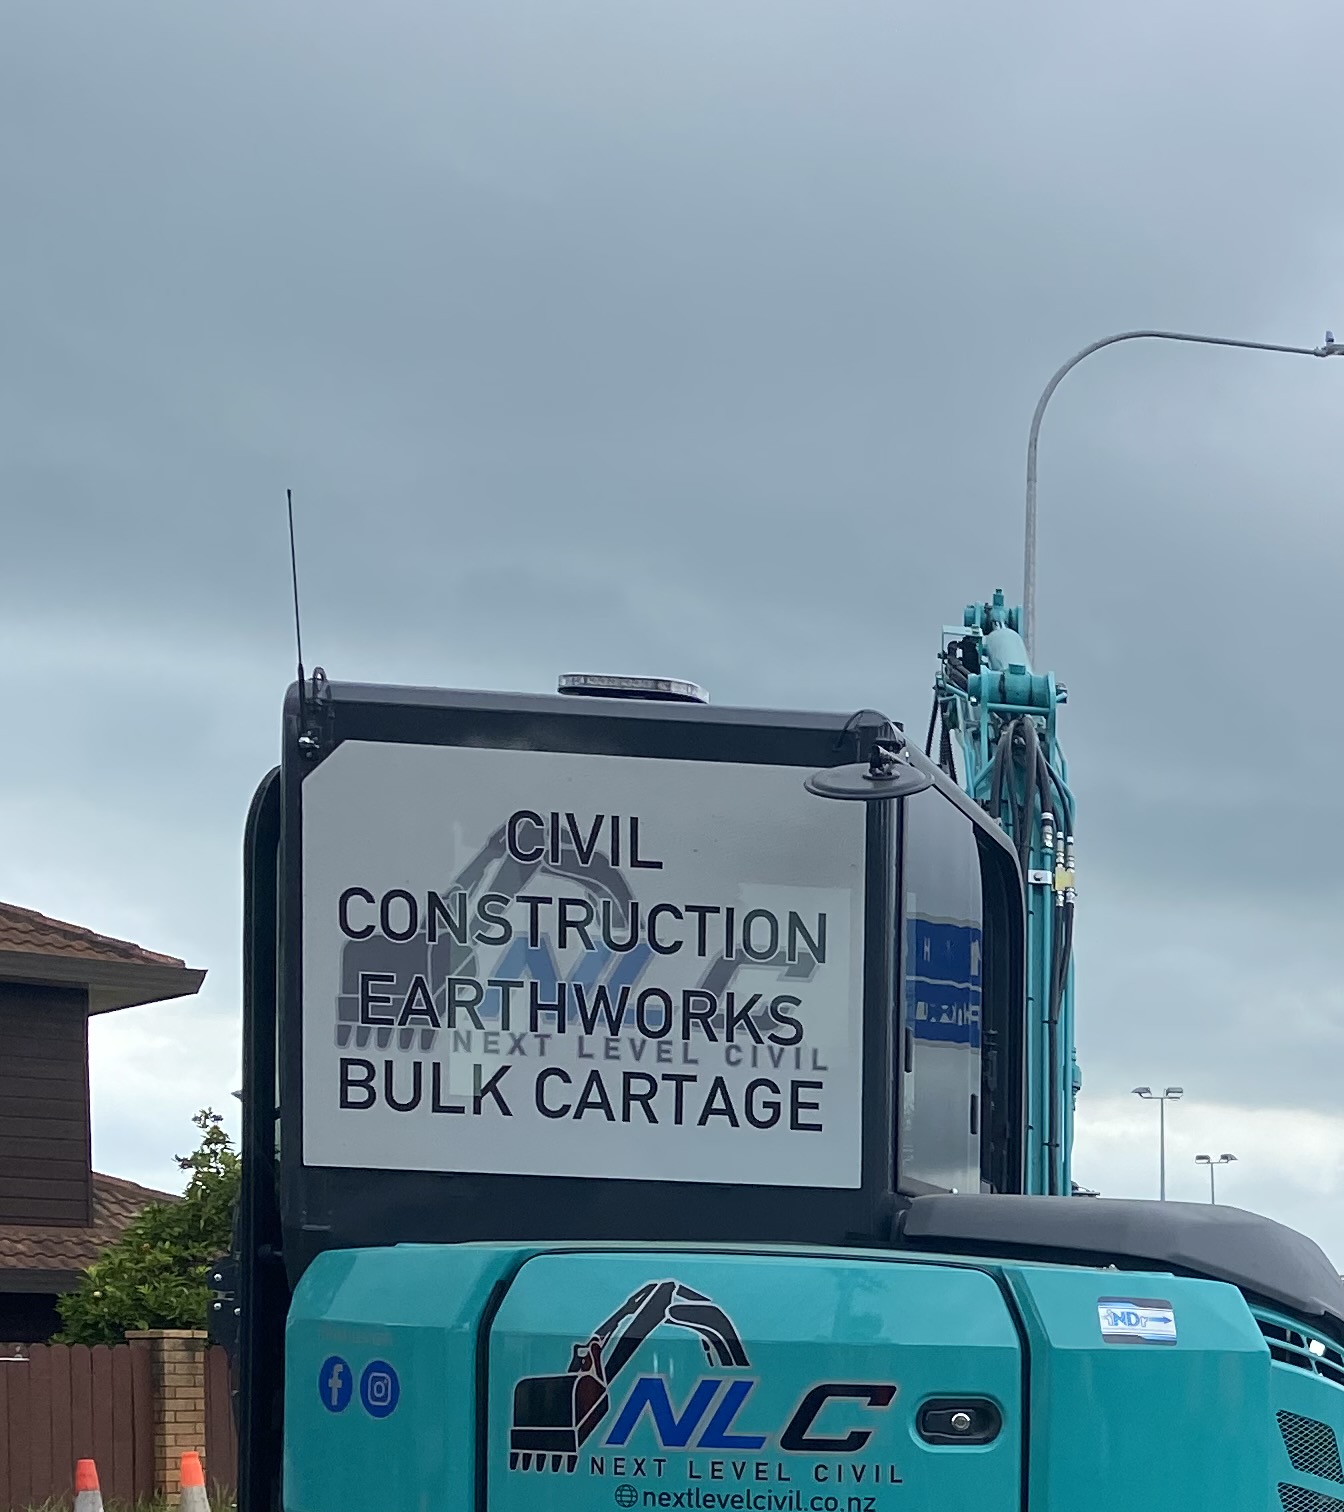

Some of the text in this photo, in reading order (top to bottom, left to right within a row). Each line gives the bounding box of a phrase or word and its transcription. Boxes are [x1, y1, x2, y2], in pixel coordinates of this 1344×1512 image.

[506, 809, 664, 870] CIVIL
[337, 886, 827, 964] CONSTRUCTION
[358, 972, 803, 1047] EARTHWORKS
[453, 1030, 828, 1071] NEXT LEVEL CIVIL
[339, 1057, 824, 1132] BULK CARTAGE
[604, 1375, 897, 1453] NLC
[590, 1456, 903, 1485] NEXT LEVEL CIVIL
[642, 1486, 877, 1512] nextlevelcivil.co.nz
